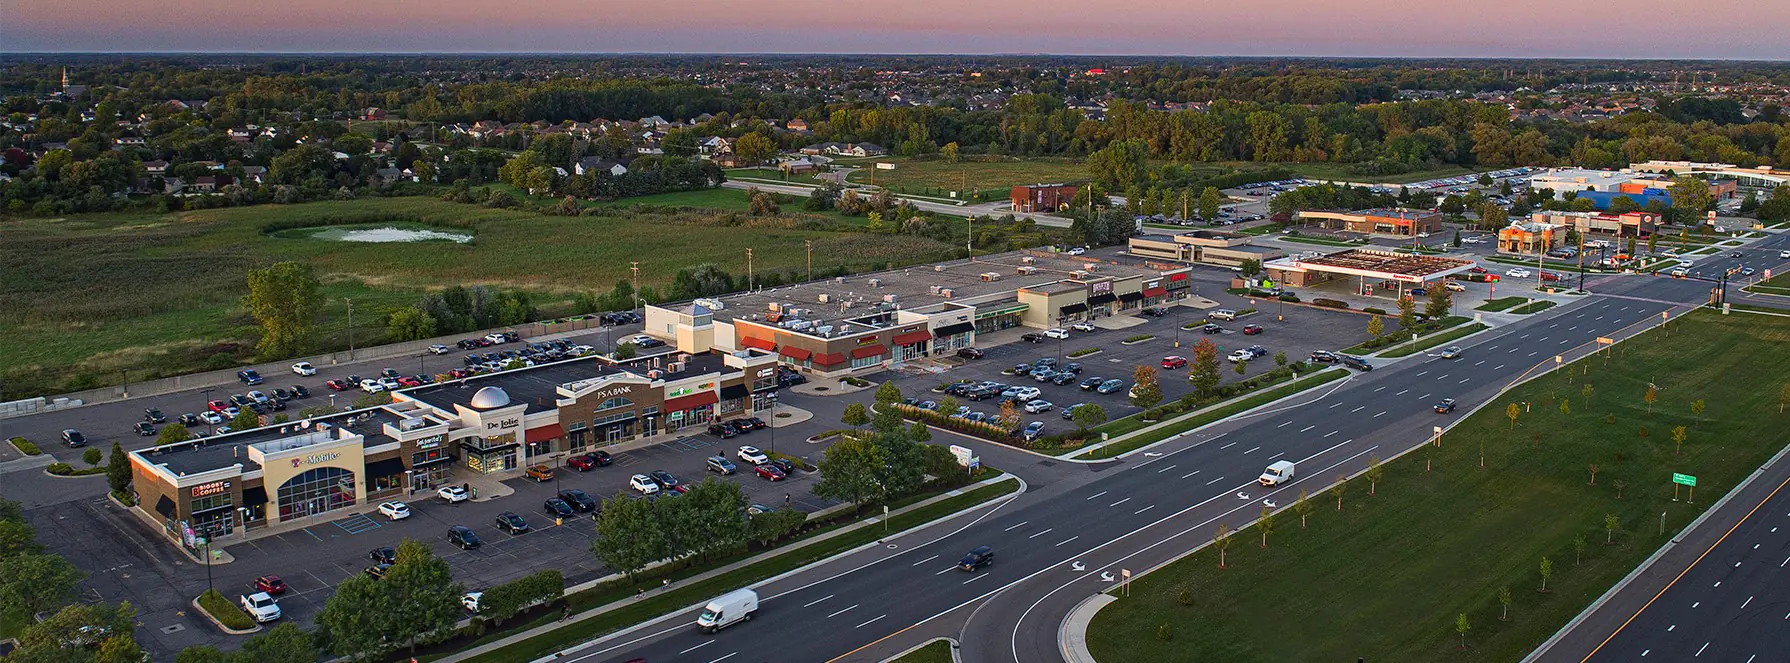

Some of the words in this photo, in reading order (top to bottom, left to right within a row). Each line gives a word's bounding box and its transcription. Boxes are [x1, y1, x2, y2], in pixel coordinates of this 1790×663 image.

[613, 386, 632, 396] BANK
[487, 422, 499, 430] De
[200, 487, 224, 496] COFFEE
